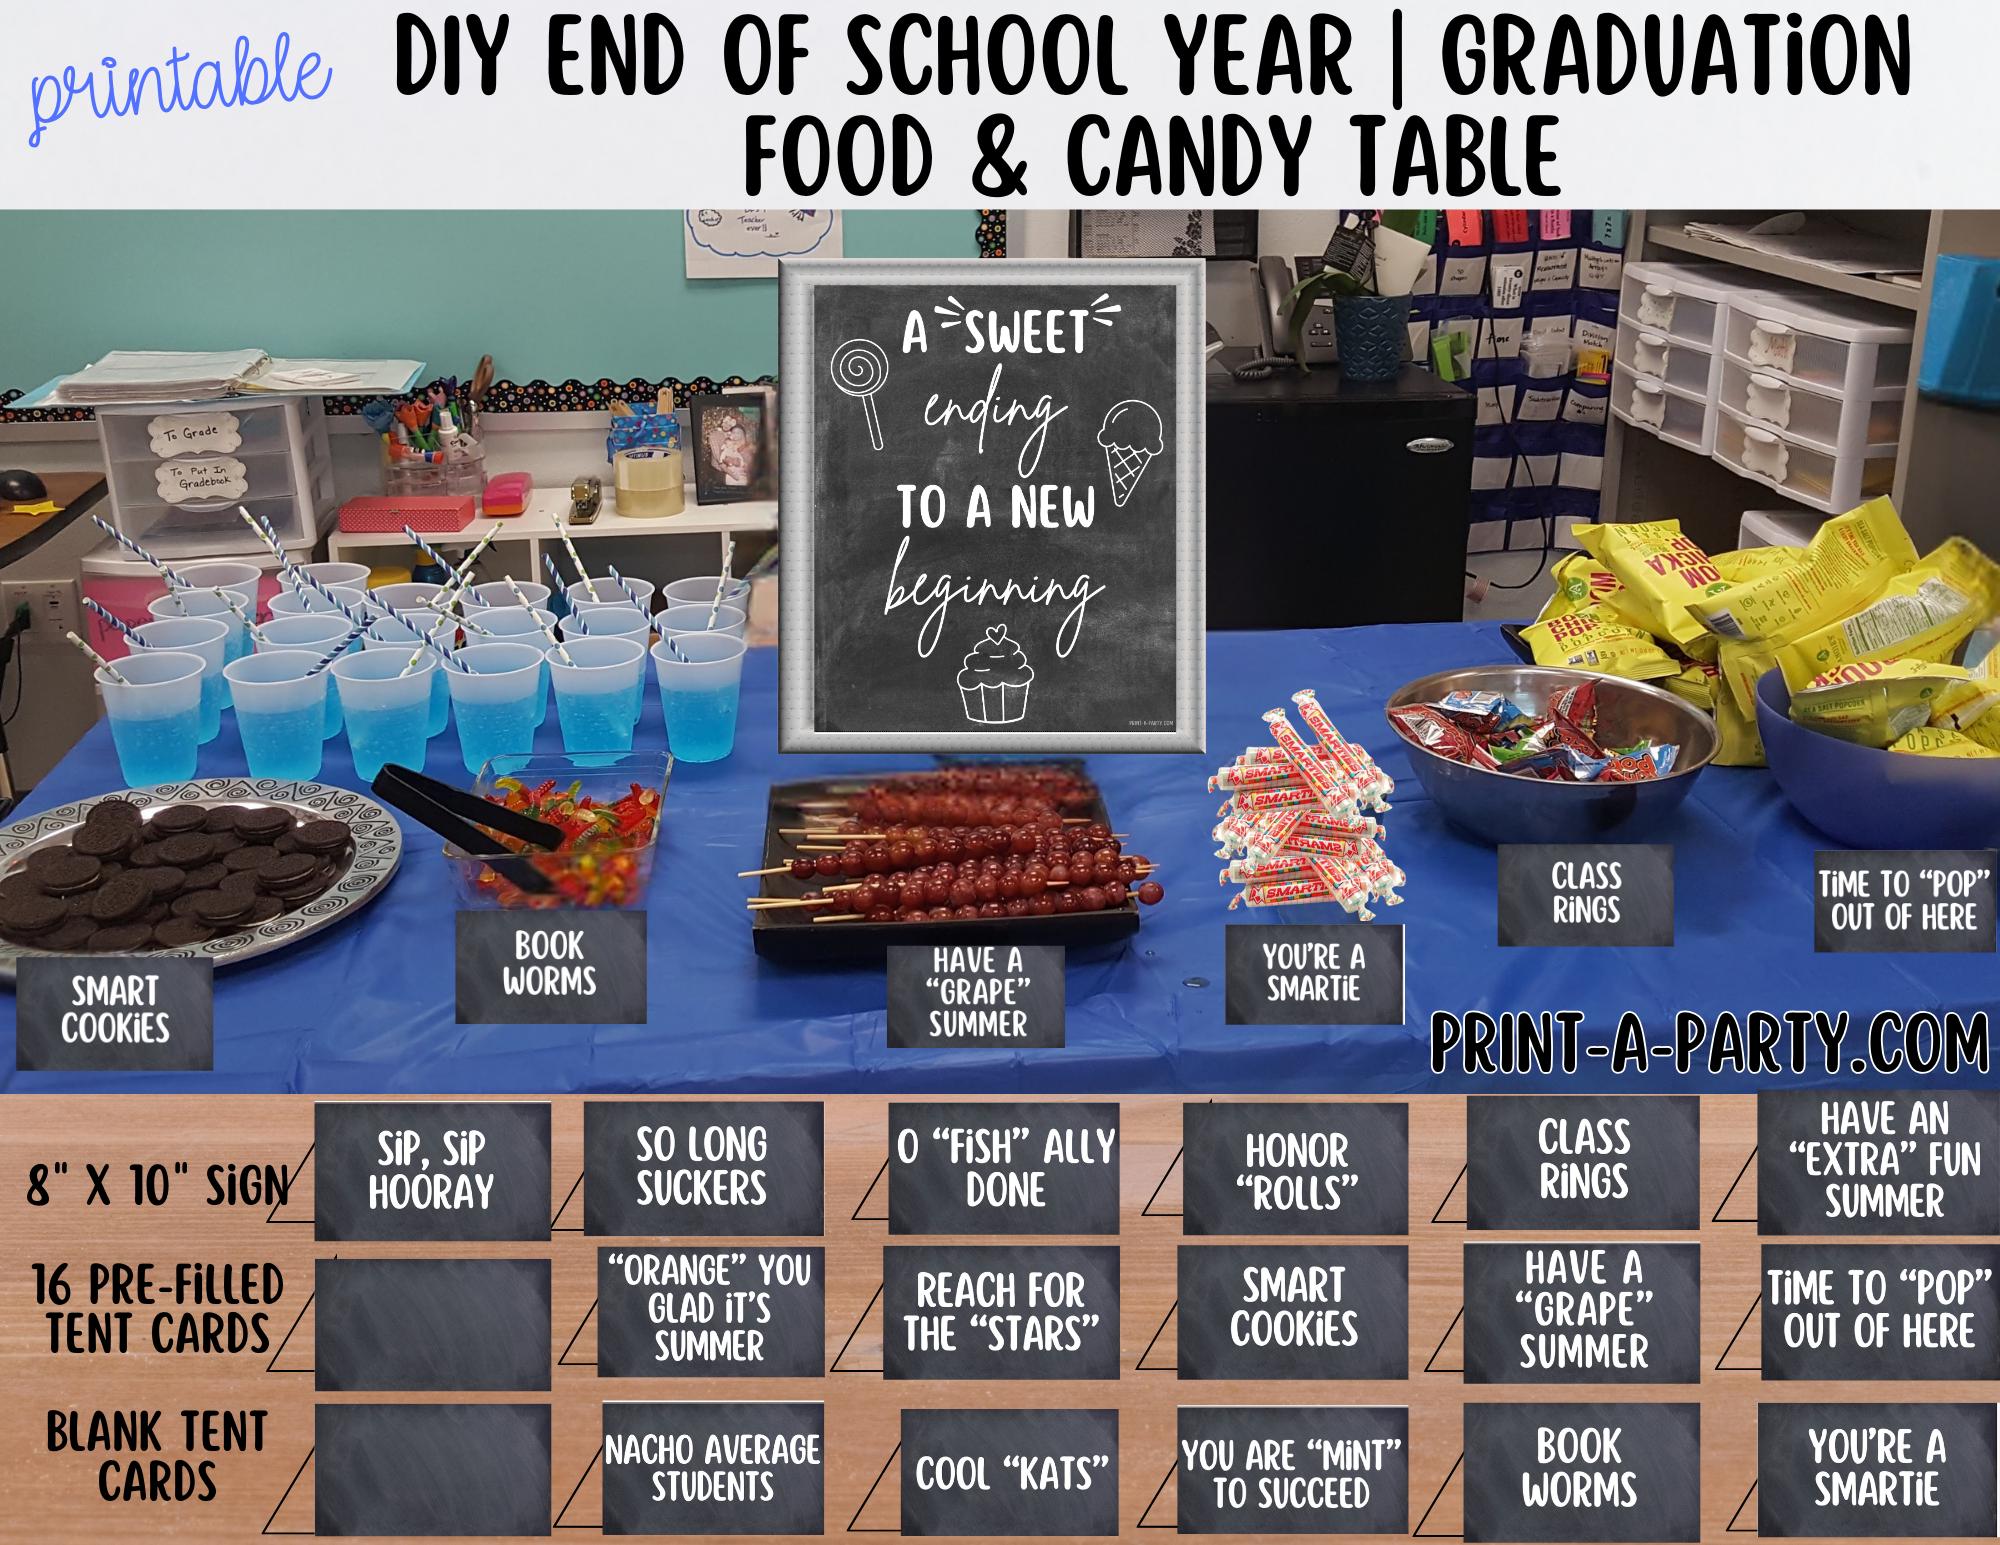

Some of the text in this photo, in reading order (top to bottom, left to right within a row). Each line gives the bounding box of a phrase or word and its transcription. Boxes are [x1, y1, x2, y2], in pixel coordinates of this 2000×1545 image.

[738, 216, 765, 224] Teacher
[903, 310, 1088, 353] A SWEET
[163, 426, 218, 441] To Grade
[925, 363, 1068, 478] ending
[170, 466, 226, 476] To Put In
[180, 476, 231, 491] Gradebook
[897, 485, 1094, 528] TO A NEW
[884, 536, 1106, 658] beginning
[1308, 715, 1359, 772] SMARTIES
[1245, 765, 1296, 779] SMART
[1280, 734, 1332, 790] SMARTIES
[1552, 862, 1621, 889] CLASS
[1881, 870, 1909, 897] TO
[1832, 903, 1977, 930] OUT OF HERE
[516, 930, 584, 959] BOOK
[935, 947, 1022, 972] HAVE A
[1351, 944, 1365, 969] A
[72, 975, 159, 1005] SMART
[504, 966, 596, 995] WORMS
[930, 1010, 1027, 1037] SUMMER
[1822, 1101, 1948, 1134] HAVE AN
[637, 1126, 766, 1161] SO LONG
[898, 1129, 918, 1163] O
[1044, 1129, 1115, 1163] ALLY
[1247, 1133, 1348, 1167] HONOR
[1539, 1118, 1630, 1154] CLASS
[1930, 1142, 1980, 1176] FUN
[370, 1174, 493, 1209] HOORAY
[637, 1169, 766, 1205] SUCKERS
[968, 1171, 1045, 1206] DONE
[1826, 1183, 1944, 1218] SUMMER
[759, 1254, 810, 1286] YOU
[1243, 1266, 1345, 1302] SMART
[1526, 1250, 1642, 1284] HAVE A
[918, 1272, 1084, 1307] REACH FOR
[1848, 1270, 1886, 1305] TO
[649, 1292, 714, 1323] GLAD
[656, 1330, 763, 1361] SUMMER
[904, 1315, 956, 1351] THE
[1784, 1313, 1975, 1348] OUT OF HERE
[1521, 1334, 1648, 1368] SUMMER
[606, 1434, 820, 1464] NACHO AVERAGE
[1182, 1440, 1233, 1471] YOU
[1246, 1440, 1295, 1470] ARE
[1538, 1427, 1621, 1463] BOOK
[1927, 1429, 1946, 1463] A
[653, 1471, 773, 1501] STUDENTS
[916, 1456, 990, 1490] COOL
[1523, 1471, 1637, 1507] WORMS
[1214, 1477, 1369, 1509] TO SUCCEED
